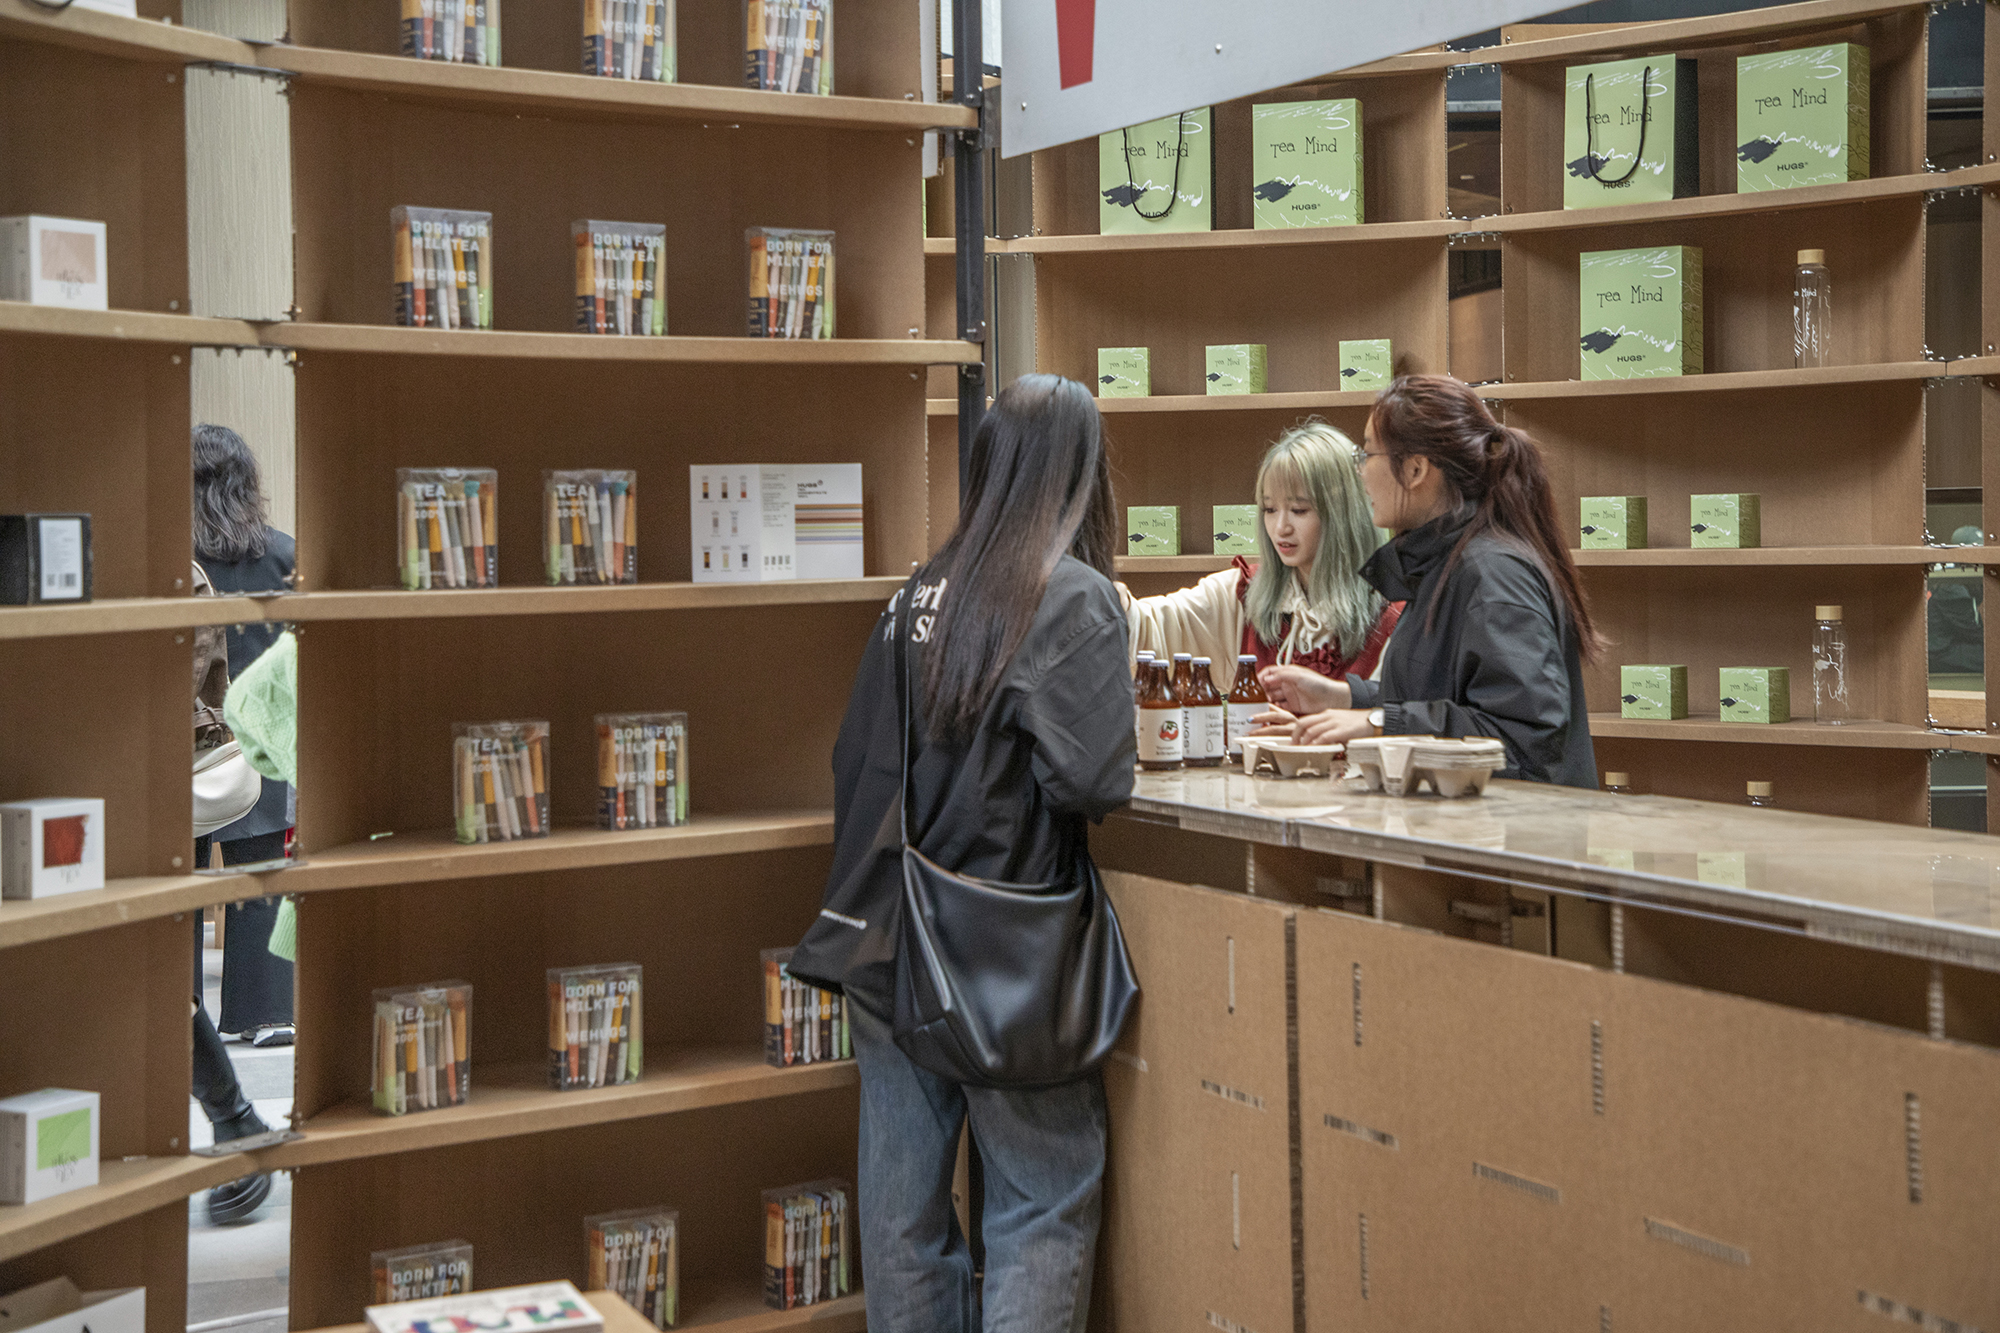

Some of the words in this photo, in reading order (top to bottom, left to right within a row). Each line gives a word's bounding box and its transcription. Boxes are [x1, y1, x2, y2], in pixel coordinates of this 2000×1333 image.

[1755, 97, 1782, 114] Tea
[1792, 88, 1827, 108] Mind
[1620, 106, 1652, 125] Mind
[1156, 141, 1189, 160] Mind
[1269, 142, 1295, 159] Tea
[1305, 137, 1337, 155] Mind
[1777, 163, 1806, 171] HUGS
[413, 220, 453, 235] BORN
[457, 223, 488, 238] FOR
[413, 236, 479, 252] MILKTEA
[594, 233, 632, 247] BORN
[635, 235, 664, 248] FOR
[766, 241, 802, 253] BORN
[806, 242, 832, 254] FOR
[594, 248, 656, 263] MILKTEA
[767, 255, 825, 268] MILKTEA
[1596, 291, 1621, 307] Tea
[1630, 285, 1662, 304] Mind
[1227, 359, 1242, 367] Mind
[1364, 353, 1379, 361] Mind
[1123, 360, 1137, 369] Mind
[414, 484, 446, 498] TEA
[557, 485, 588, 497] TEA
[1602, 511, 1616, 519] Mind
[1714, 508, 1728, 517] Mind
[1151, 519, 1166, 528] Mind
[1236, 518, 1251, 527] Mind
[1645, 680, 1659, 689] Mind
[1743, 683, 1757, 692] Mind
[614, 728, 653, 740] BORN
[472, 739, 502, 752] TEA
[566, 984, 605, 998] BORN
[609, 979, 638, 994] FOR
[566, 996, 630, 1013] MILKTEA
[396, 1006, 425, 1023] TEA
[604, 1231, 643, 1247] BORN
[392, 1266, 434, 1284] BORN
[438, 1261, 468, 1277] FOR
